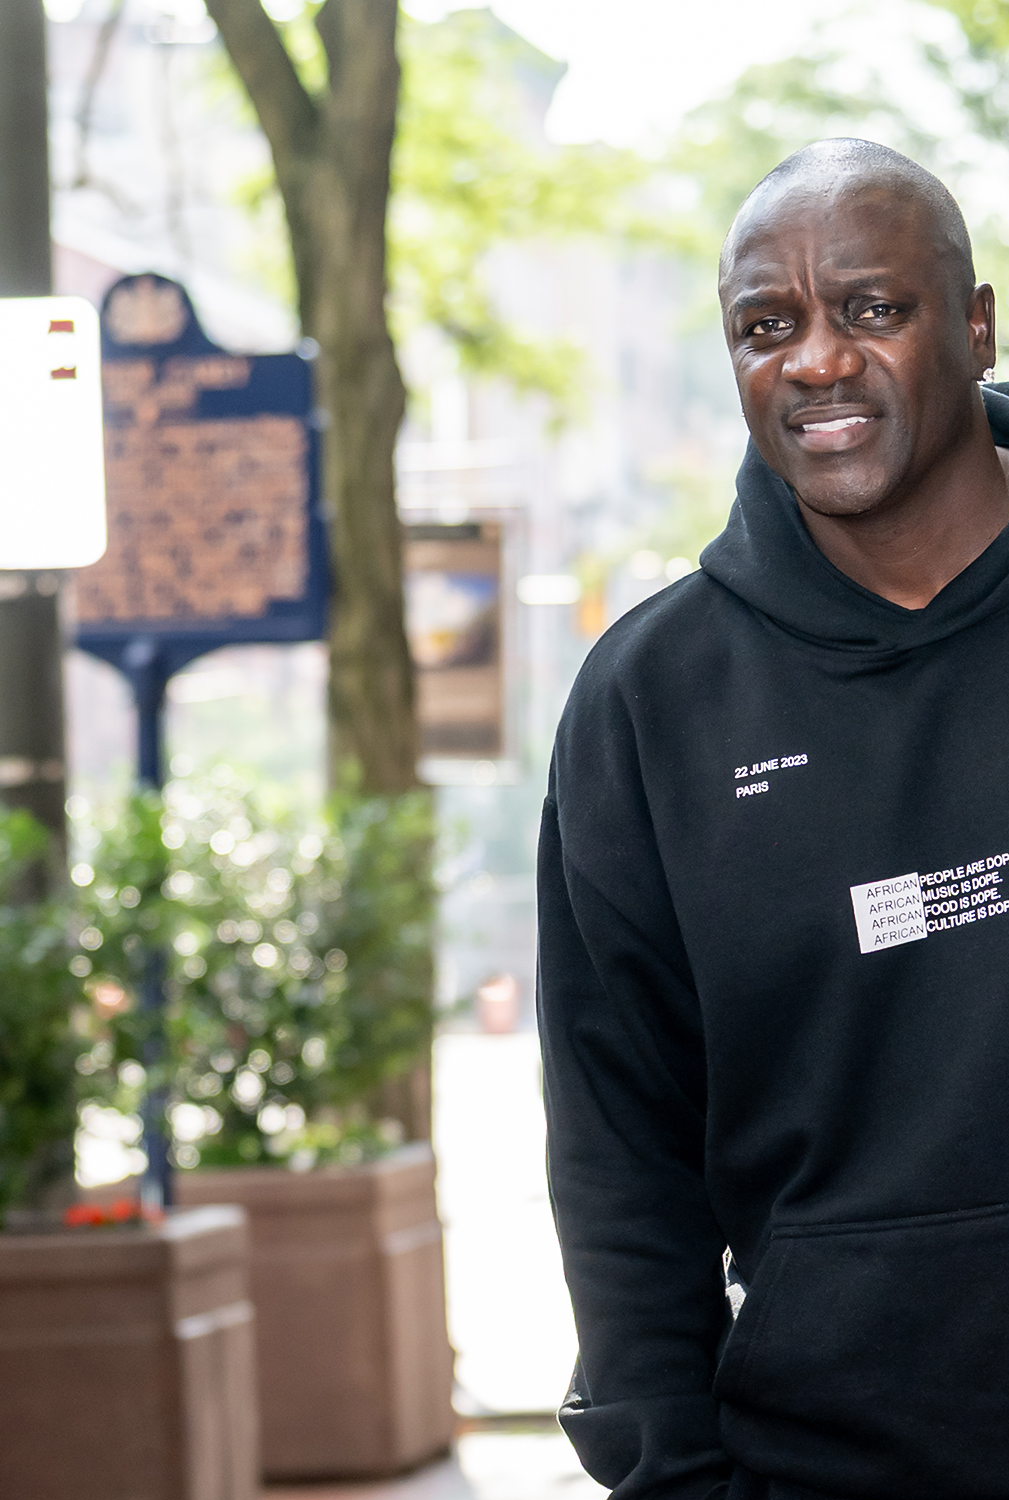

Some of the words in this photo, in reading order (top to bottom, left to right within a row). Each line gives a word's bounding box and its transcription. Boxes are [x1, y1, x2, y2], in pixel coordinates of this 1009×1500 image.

[734, 766, 749, 779] 22
[749, 758, 780, 776] JUNE
[780, 753, 808, 769] 2023
[735, 780, 770, 799] PARIS
[866, 878, 918, 899] AFRICAN
[918, 866, 966, 887] PEOPLE
[965, 860, 986, 876] ARE
[869, 894, 920, 915] AFRICAN
[922, 884, 960, 903] MUSIC
[960, 881, 971, 894] IS
[972, 871, 1003, 891] DOPE.
[871, 909, 923, 930] AFRICAN
[924, 900, 958, 918] FOOD
[959, 896, 970, 910] IS
[971, 887, 1001, 907] DOPE.
[874, 924, 924, 946] AFRICAN
[926, 910, 977, 932] CULTURE
[977, 907, 987, 920] IS
